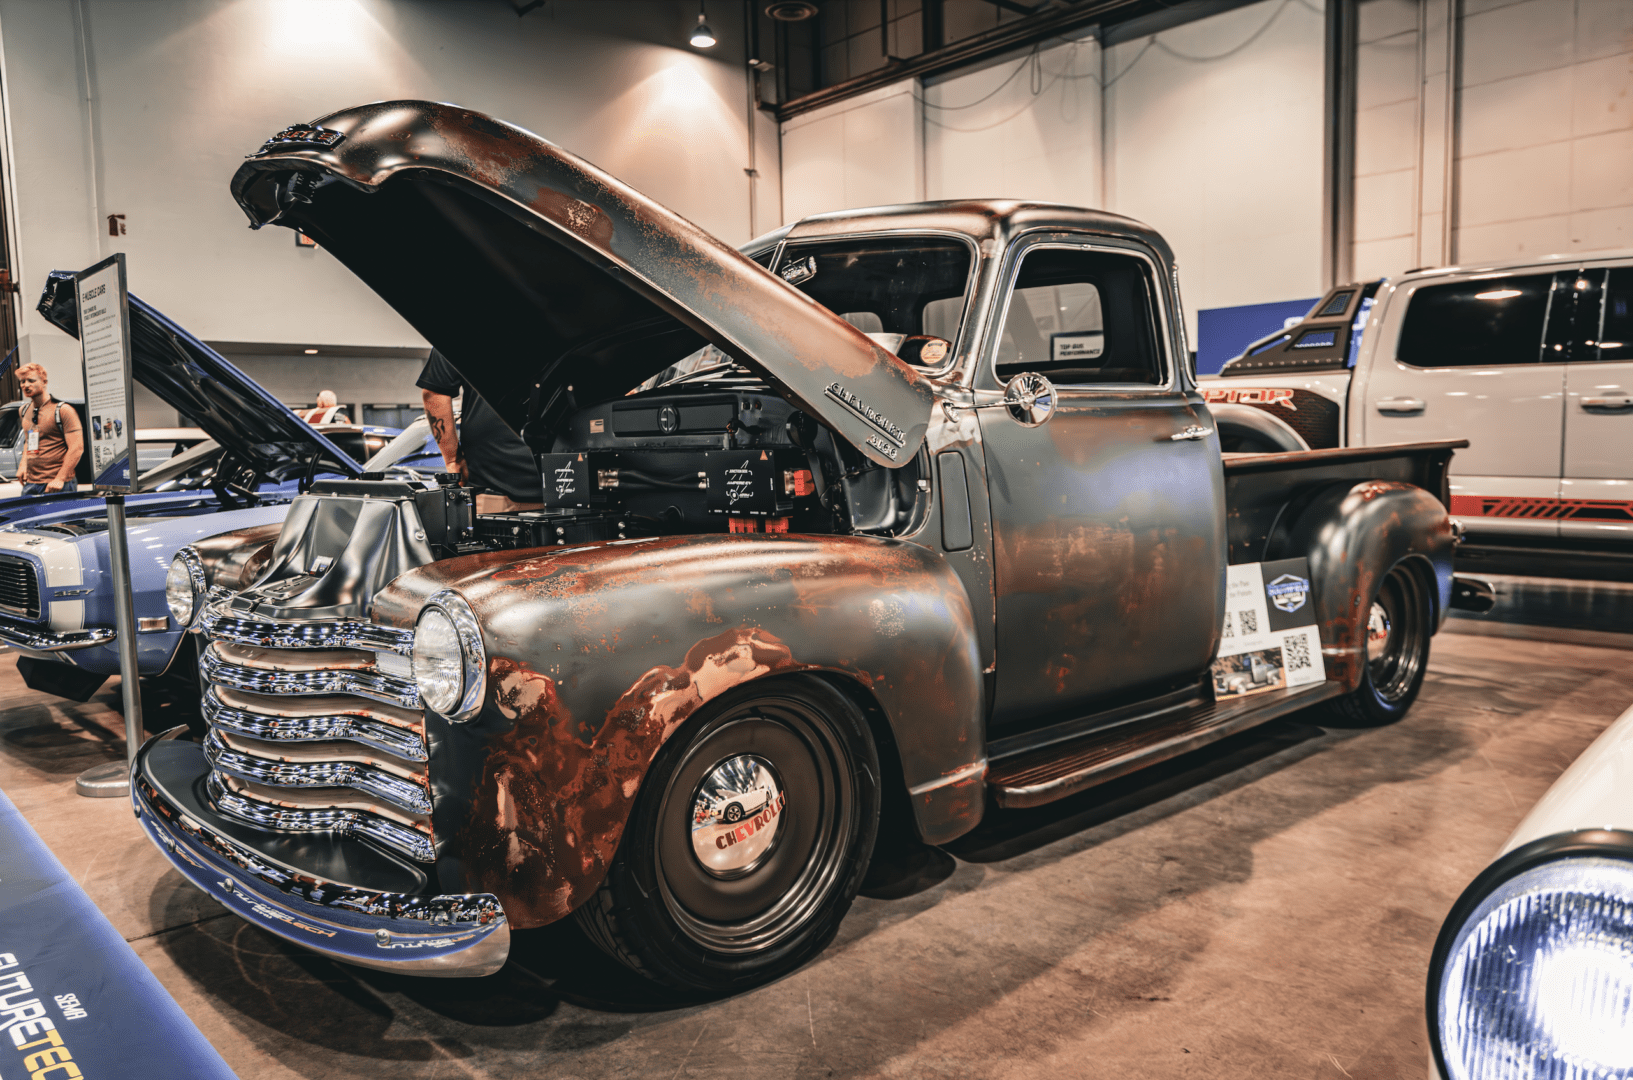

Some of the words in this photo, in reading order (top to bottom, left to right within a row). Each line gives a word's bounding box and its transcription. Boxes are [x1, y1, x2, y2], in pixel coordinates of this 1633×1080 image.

[830, 382, 907, 441] CHEVROLET
[54, 588, 95, 598] 427
[715, 789, 786, 850] CHEVROLET
[0, 952, 84, 1080] TURETEC
[53, 992, 88, 1021] SEMA
